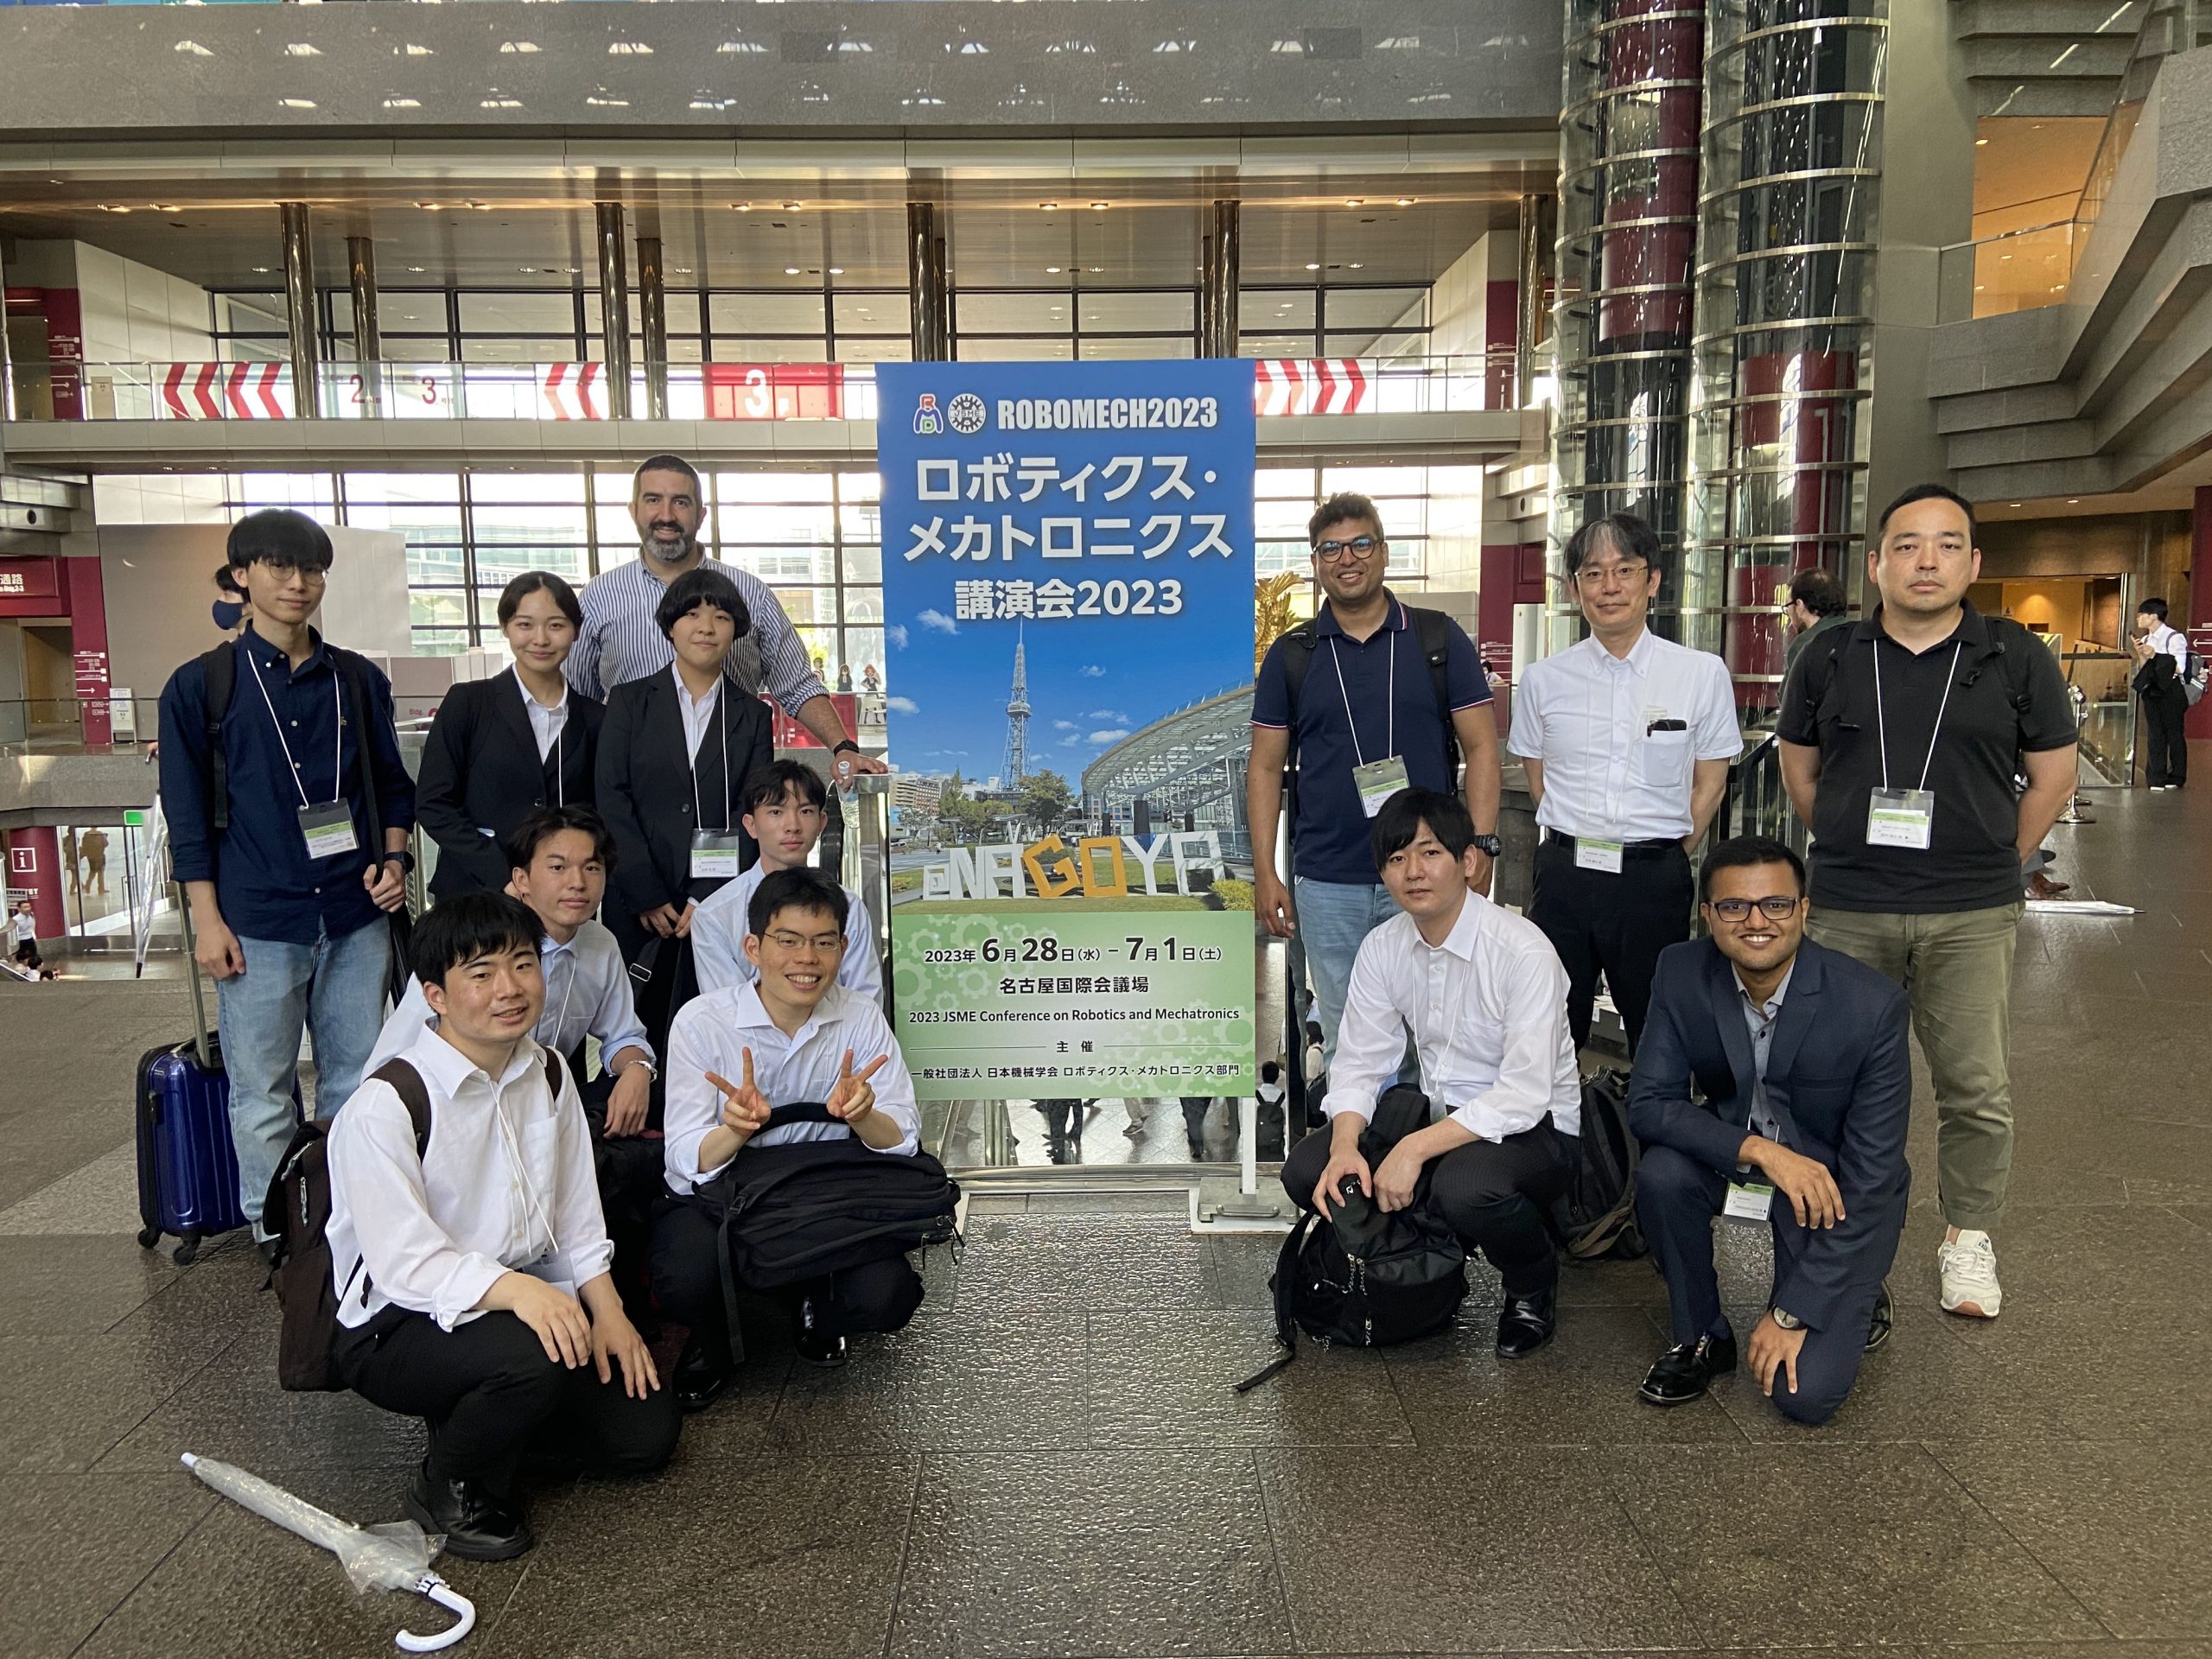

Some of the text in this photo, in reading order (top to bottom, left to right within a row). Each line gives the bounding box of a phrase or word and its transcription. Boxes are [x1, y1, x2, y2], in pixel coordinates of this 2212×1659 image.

[997, 397, 1217, 429] ROBOMECH2023
[903, 514, 1233, 562] メカトロニクス
[955, 578, 1182, 620] 講演会2023
[1000, 976, 1149, 994] 名古屋国際会議場
[909, 1007, 1239, 1023] 2023 JSME Conference on Robotics and Mechatronics
[911, 1067, 982, 1079] 一般社団法人
[988, 1066, 1058, 1078] 日本機械学会
